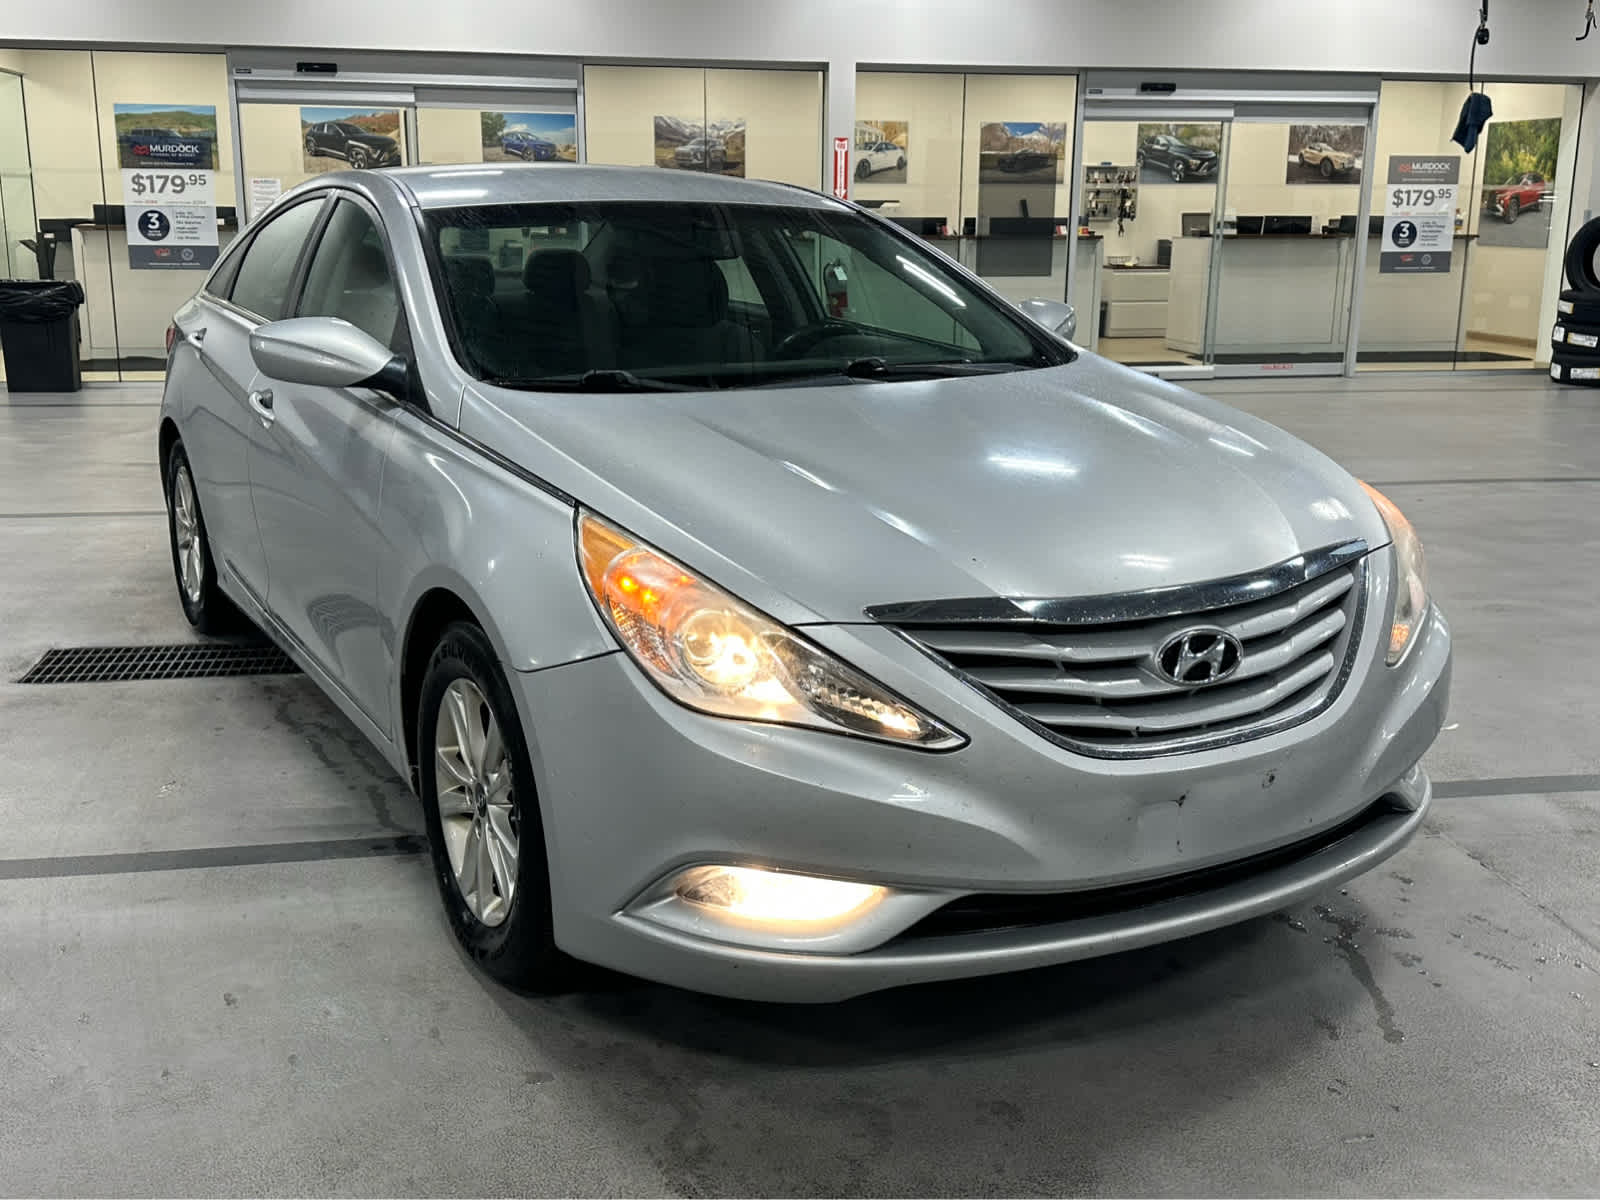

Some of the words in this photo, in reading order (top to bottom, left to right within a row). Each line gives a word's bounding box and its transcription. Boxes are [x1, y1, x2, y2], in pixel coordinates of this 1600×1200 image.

[150, 144, 199, 153] MURDOCK
[1412, 162, 1450, 170] MURDOCK
[147, 212, 160, 229] 3
[1399, 223, 1410, 237] 3
